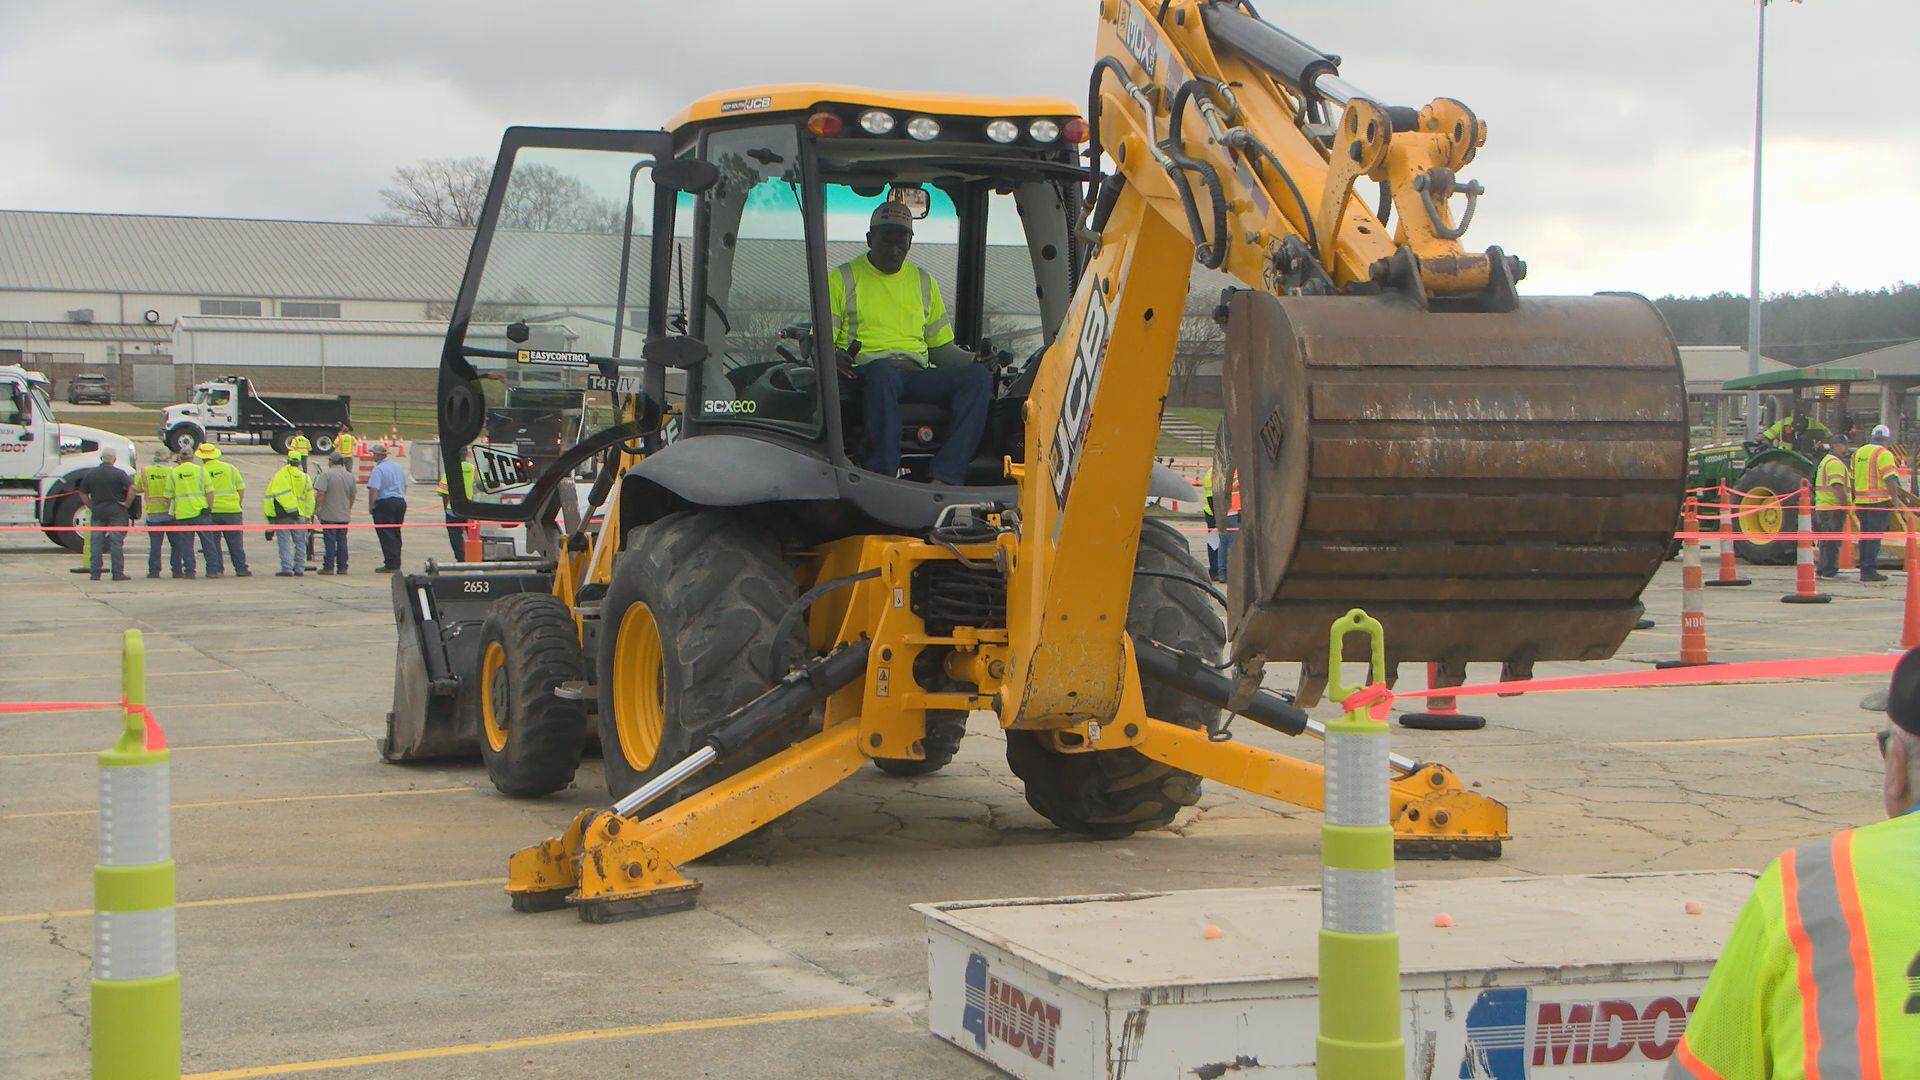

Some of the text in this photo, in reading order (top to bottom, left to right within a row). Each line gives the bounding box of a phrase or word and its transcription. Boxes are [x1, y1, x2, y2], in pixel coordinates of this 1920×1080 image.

[746, 98, 771, 109] JCB
[531, 351, 589, 362] EASYCONTROL
[1053, 289, 1106, 497] JCB
[464, 580, 490, 593] 2653
[988, 976, 1062, 1068] MDOT
[1532, 996, 1701, 1066] MDO
